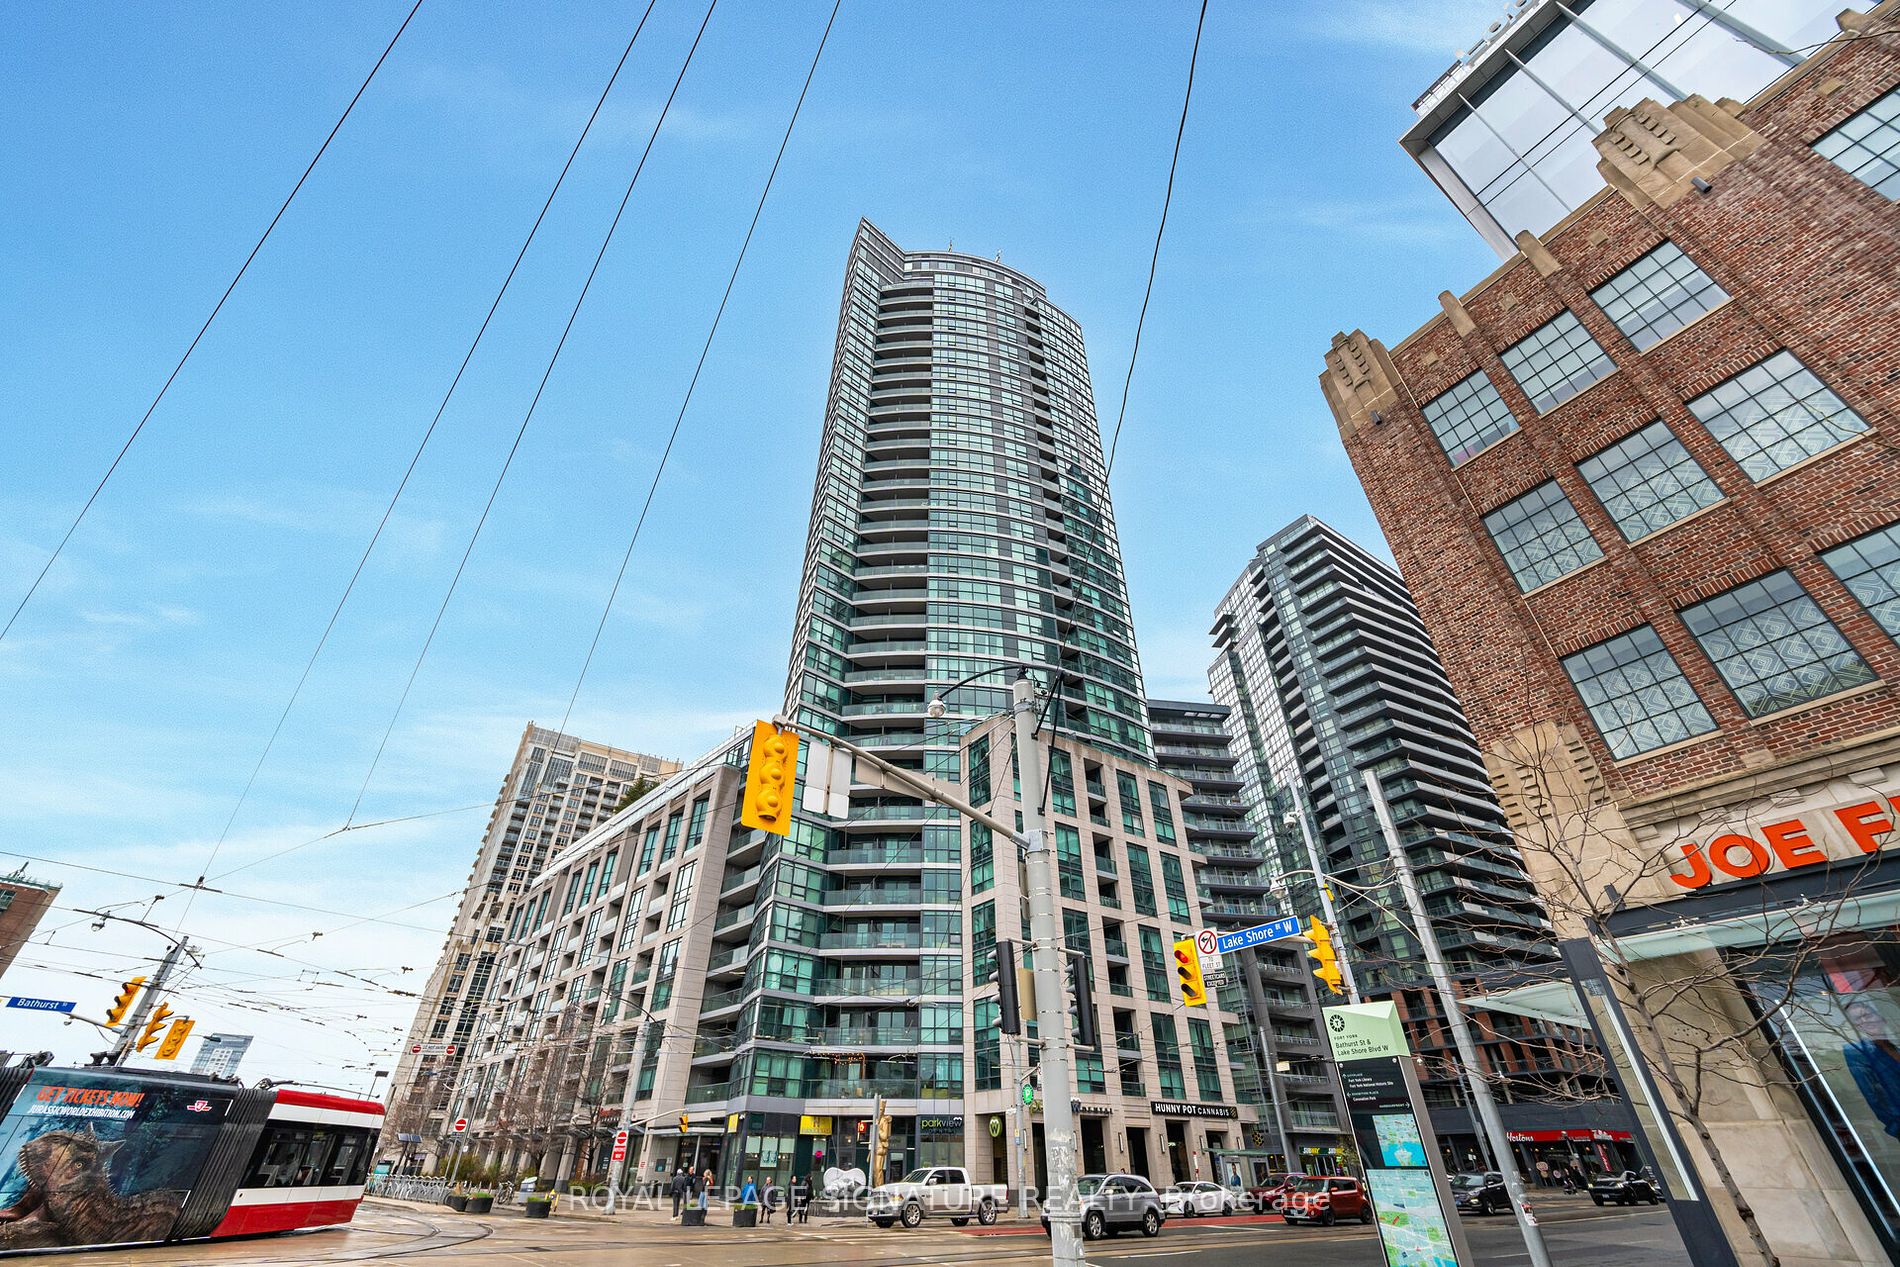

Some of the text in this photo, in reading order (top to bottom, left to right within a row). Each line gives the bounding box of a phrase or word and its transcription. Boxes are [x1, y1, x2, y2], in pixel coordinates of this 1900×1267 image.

[1670, 796, 1900, 889] JOE F
[1222, 936, 1244, 949] Lake
[1246, 928, 1274, 943] Shore
[1283, 920, 1293, 933] W
[17, 998, 59, 1010] Bathurst
[36, 1086, 145, 1108] GET TICKETS NOW!
[28, 1104, 136, 1119] JURASSICWORLDEXHIBITION.COM
[1155, 1103, 1229, 1116] HUNNY POT CANNABIS
[921, 1117, 962, 1129] parkview
[1507, 1131, 1534, 1142] Hortons
